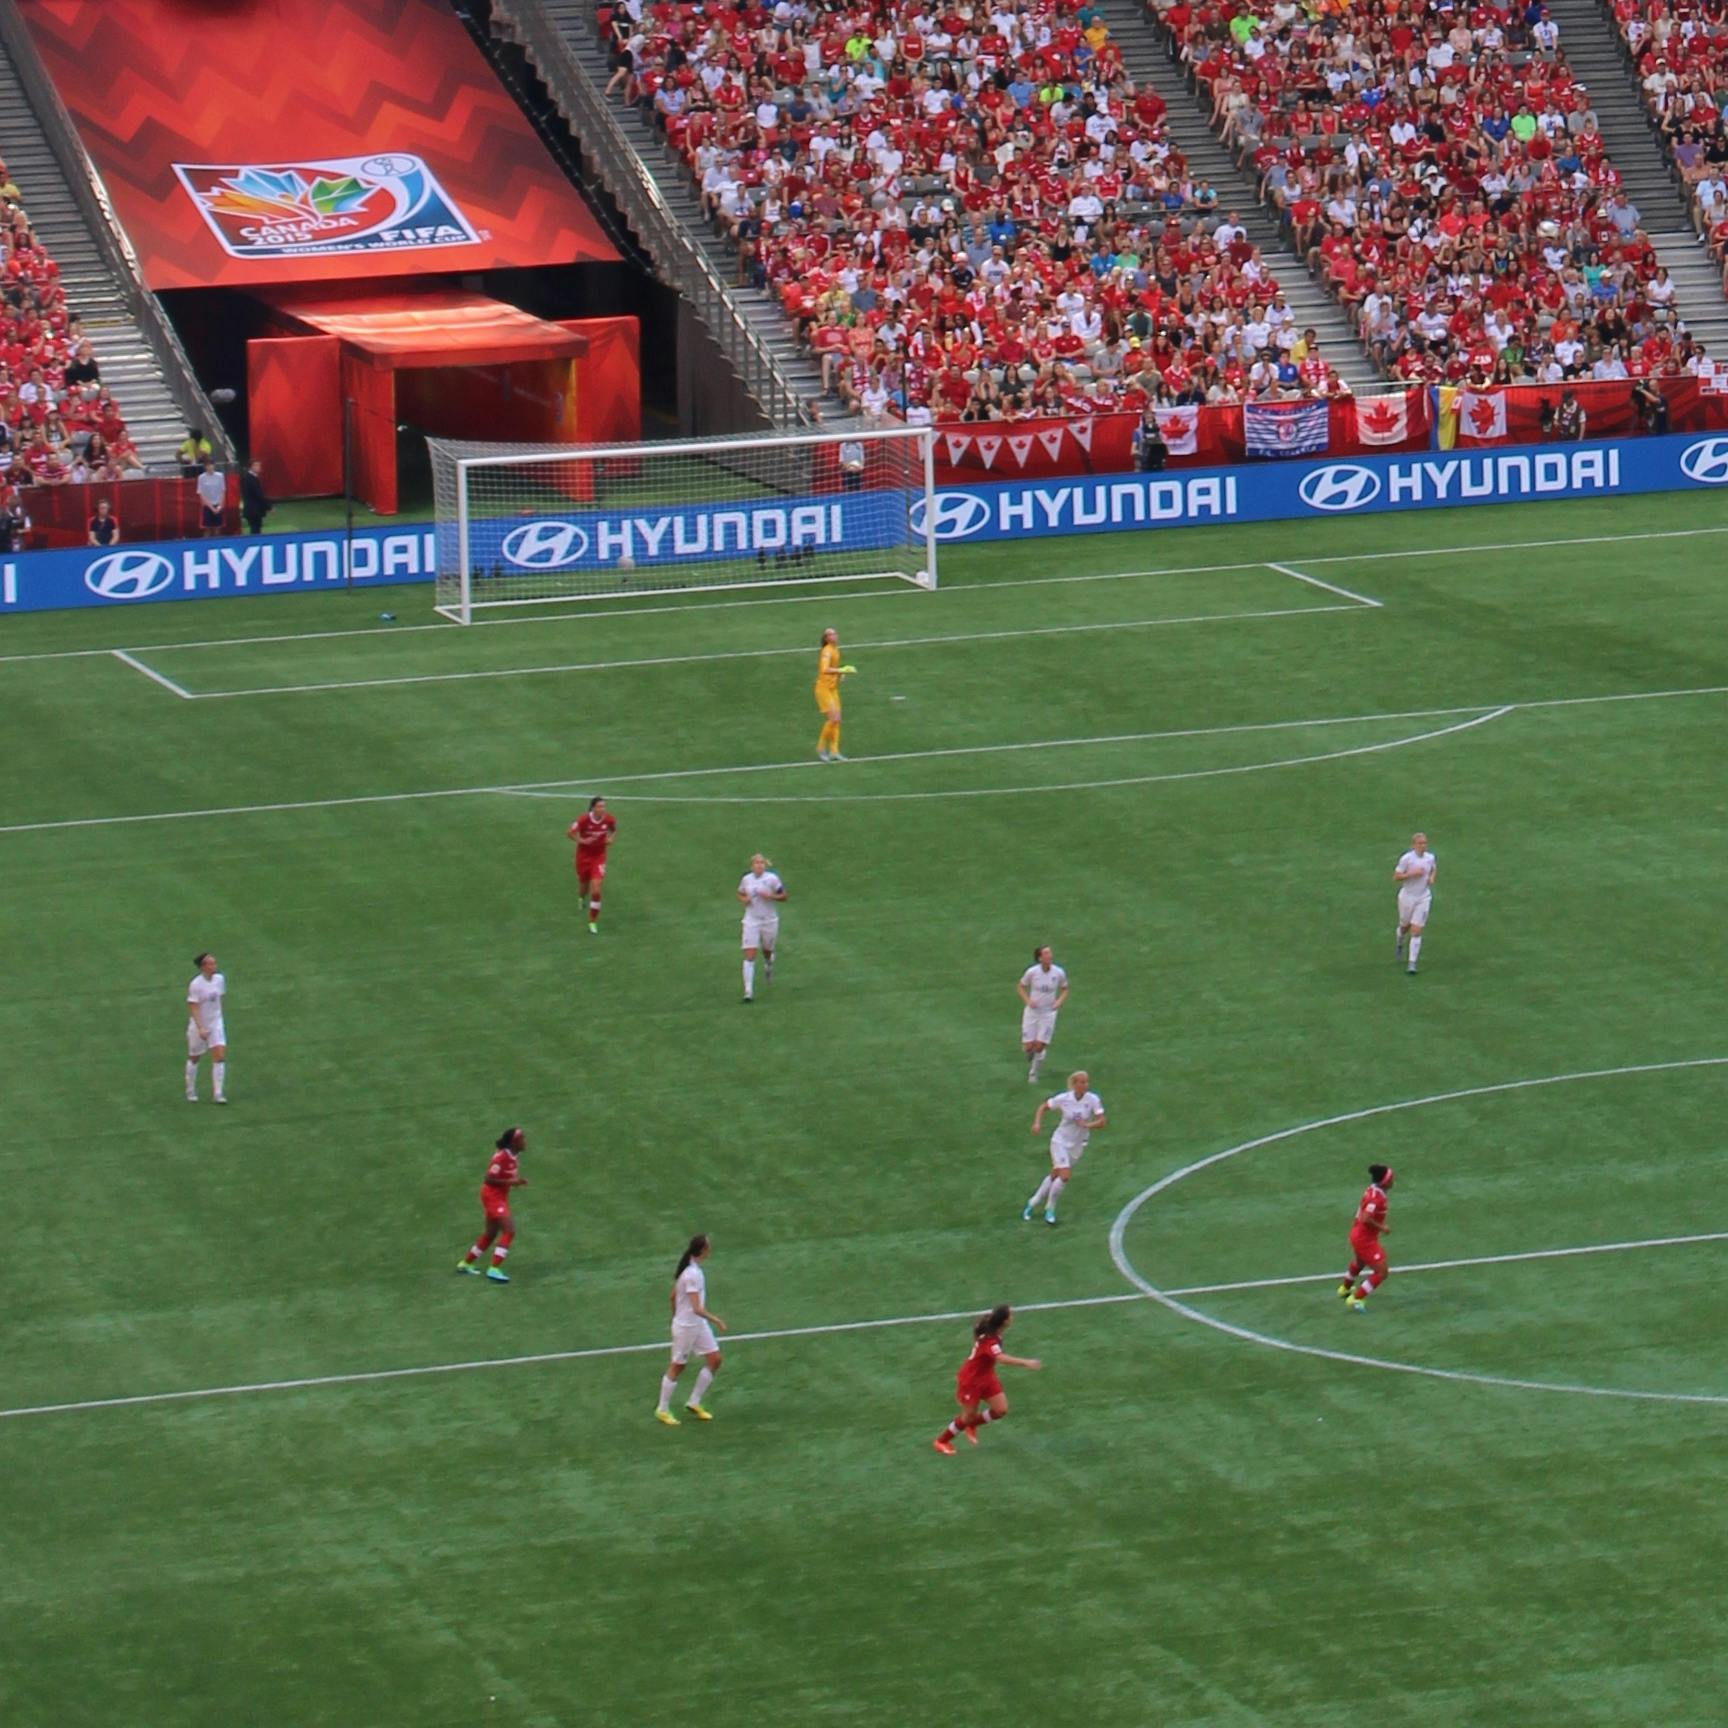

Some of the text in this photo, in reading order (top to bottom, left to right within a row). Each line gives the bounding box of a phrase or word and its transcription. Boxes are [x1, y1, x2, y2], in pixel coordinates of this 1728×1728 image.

[239, 215, 359, 238] CANADA
[252, 231, 313, 246] 2015
[280, 242, 367, 254] WOMEN'S
[367, 238, 431, 250] WORLD
[432, 234, 467, 244] CUP
[378, 225, 464, 241] FIFA
[1388, 449, 1620, 502] HYUNDAI
[998, 476, 1237, 532] HYUNDAI
[598, 504, 843, 560] HYUNDAI
[183, 533, 436, 590] HYUNDAI
